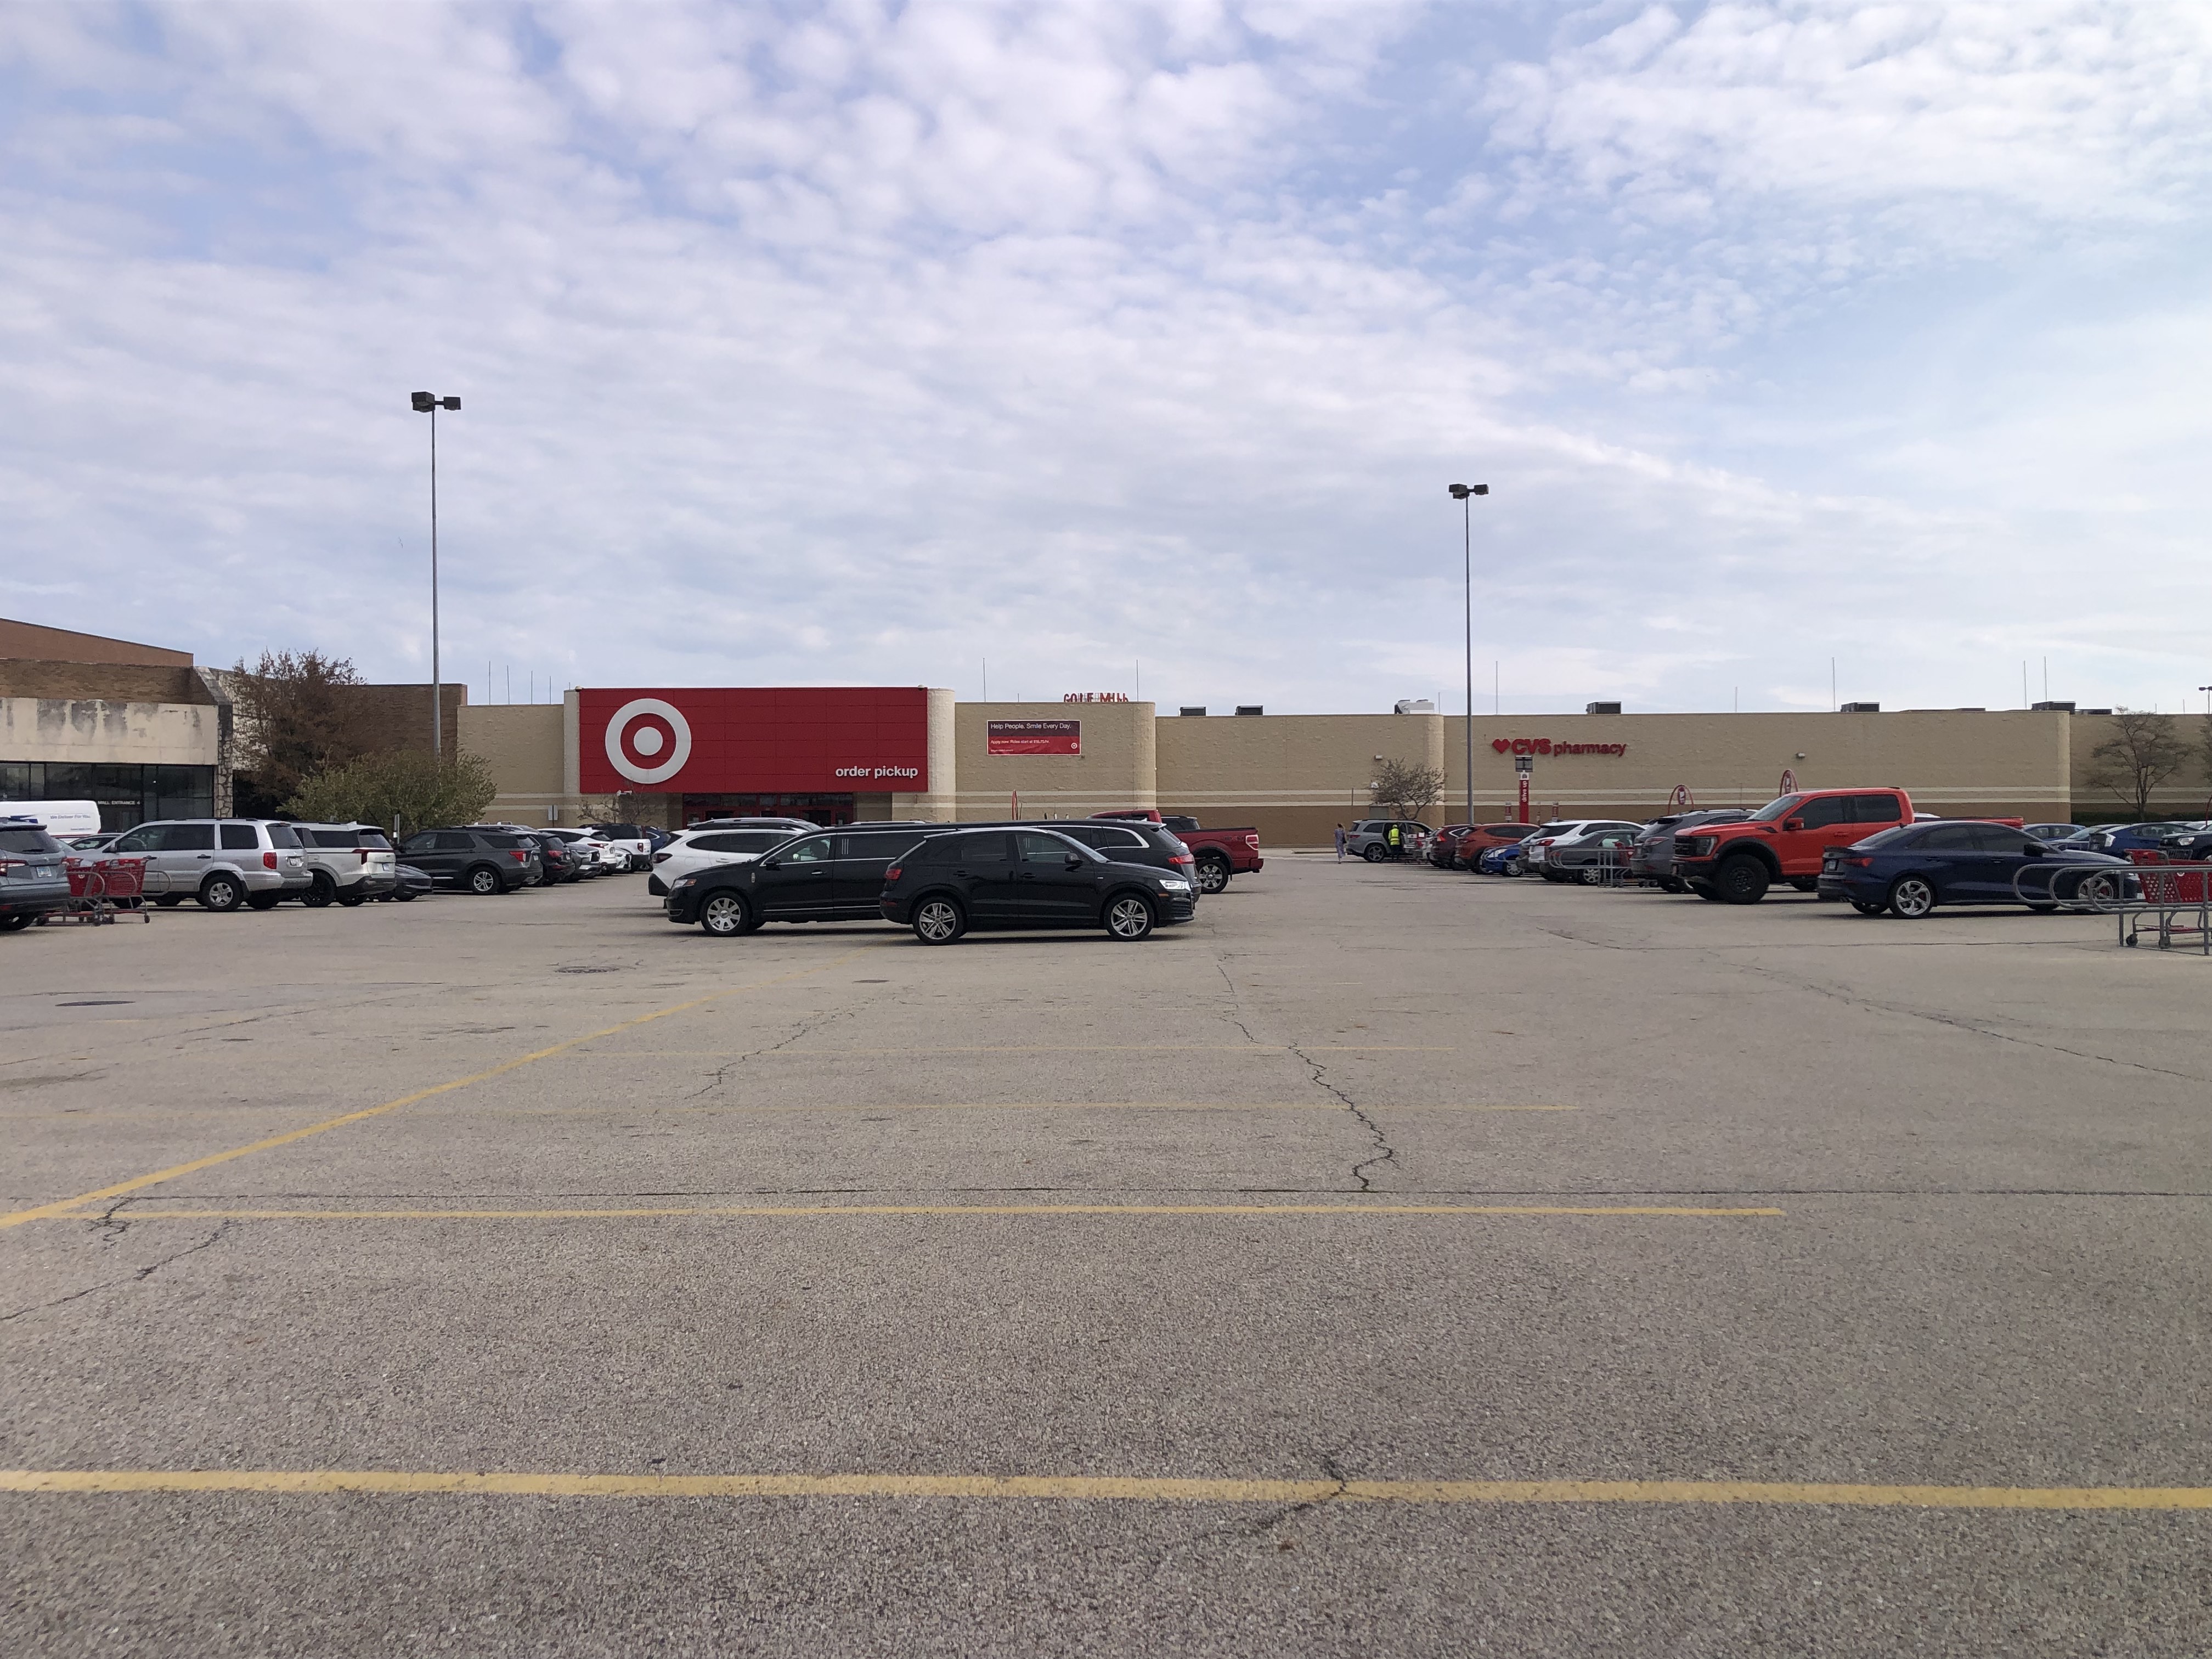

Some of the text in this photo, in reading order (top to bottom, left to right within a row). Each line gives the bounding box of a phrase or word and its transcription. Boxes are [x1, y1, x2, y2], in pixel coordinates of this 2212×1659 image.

[1511, 738, 1627, 757] CVS pharmacy
[836, 765, 918, 779] order pickup
